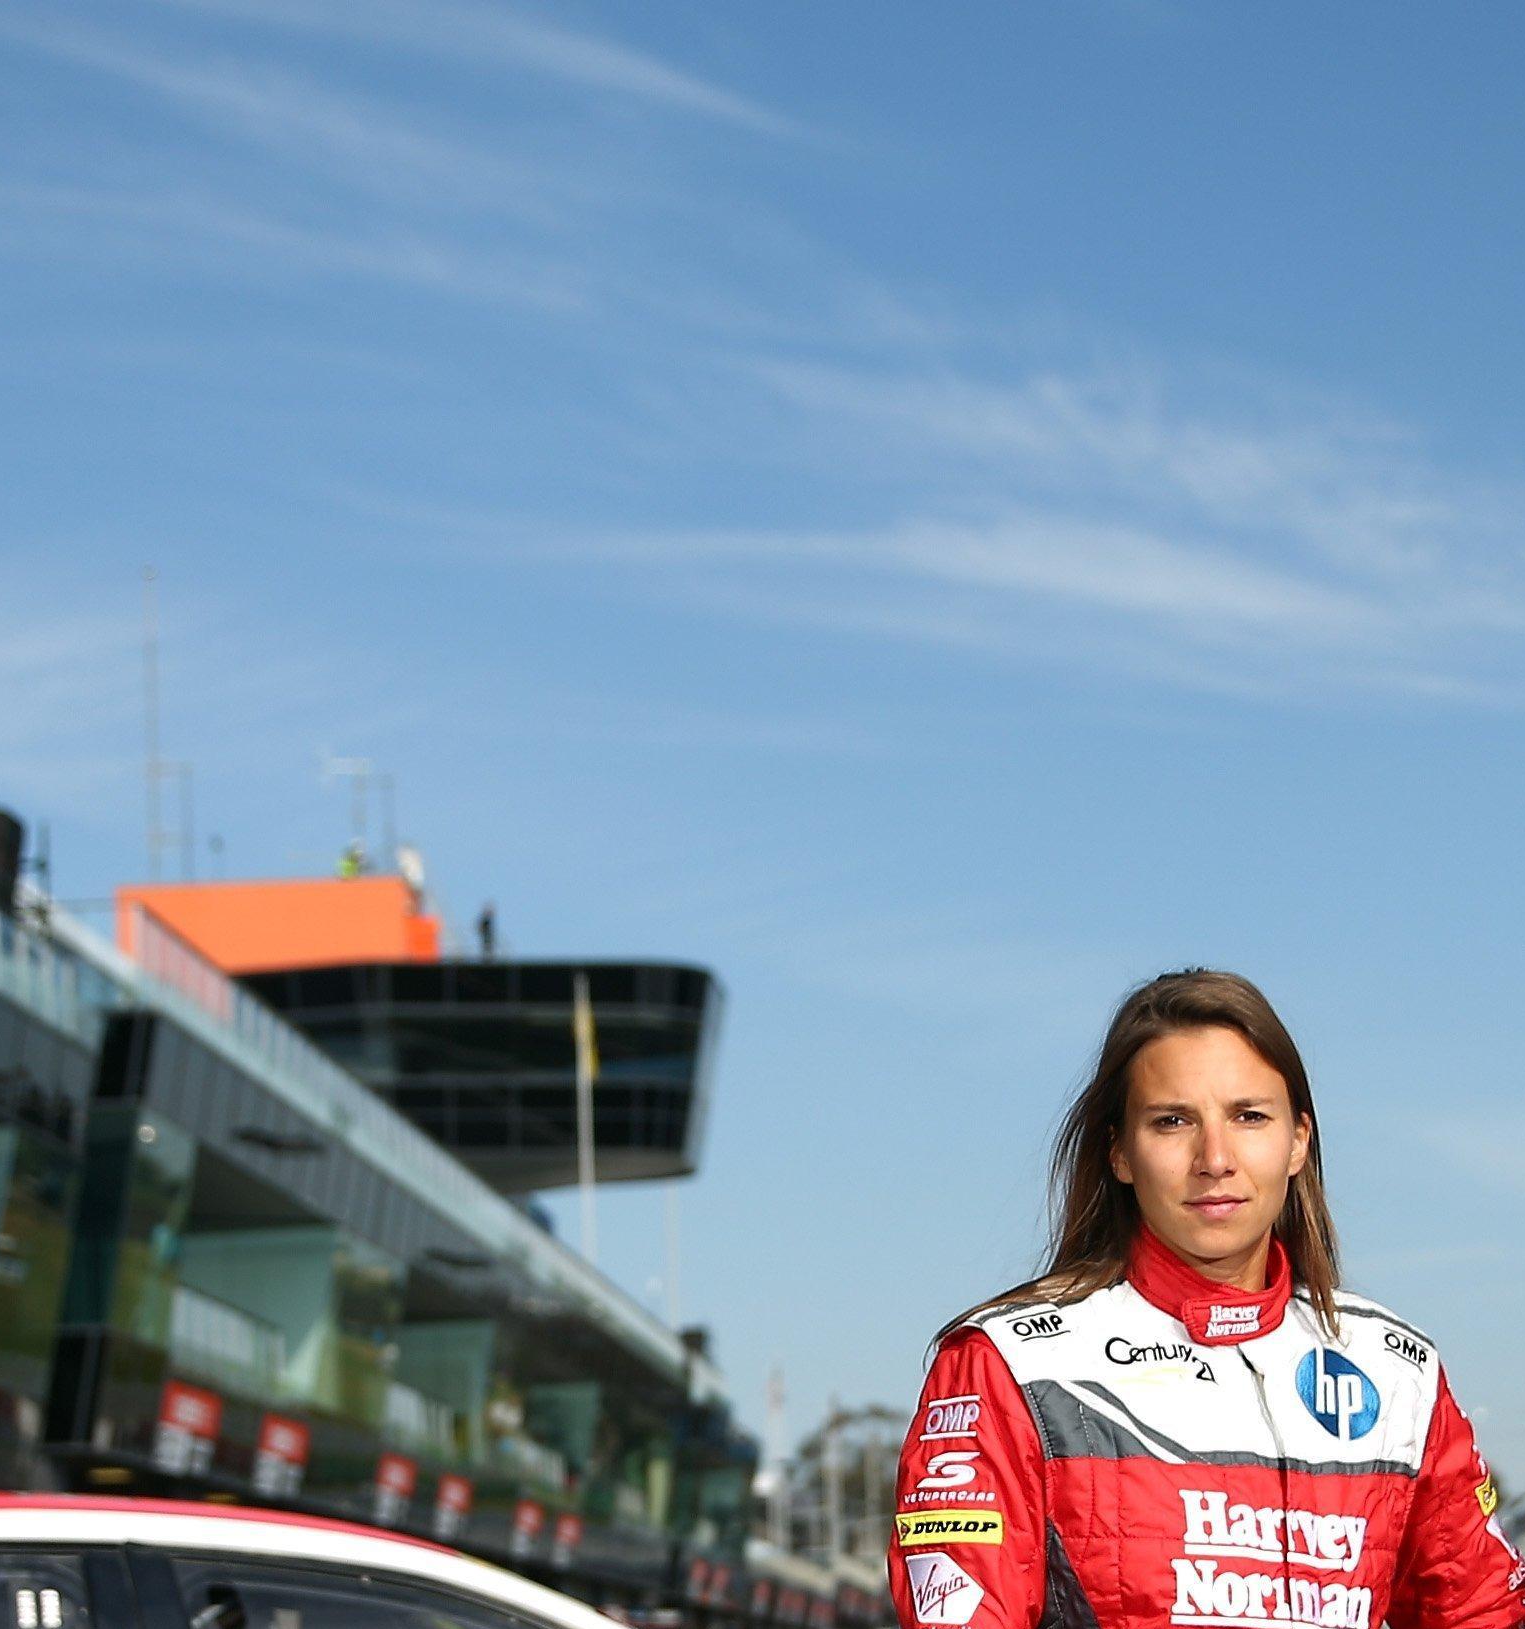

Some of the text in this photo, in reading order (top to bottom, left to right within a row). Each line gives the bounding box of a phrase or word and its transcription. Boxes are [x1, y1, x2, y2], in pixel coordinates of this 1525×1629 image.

[1012, 1314, 1063, 1337] OMP
[1210, 1305, 1262, 1322] Harvey
[1205, 1320, 1260, 1338] Norman
[1104, 1336, 1193, 1365] Century
[1383, 1332, 1427, 1364] OMP
[925, 1402, 981, 1434] OMP
[912, 1521, 999, 1535] DUNLOP
[1178, 1489, 1368, 1573] Harvey
[916, 1563, 970, 1618] Virgin
